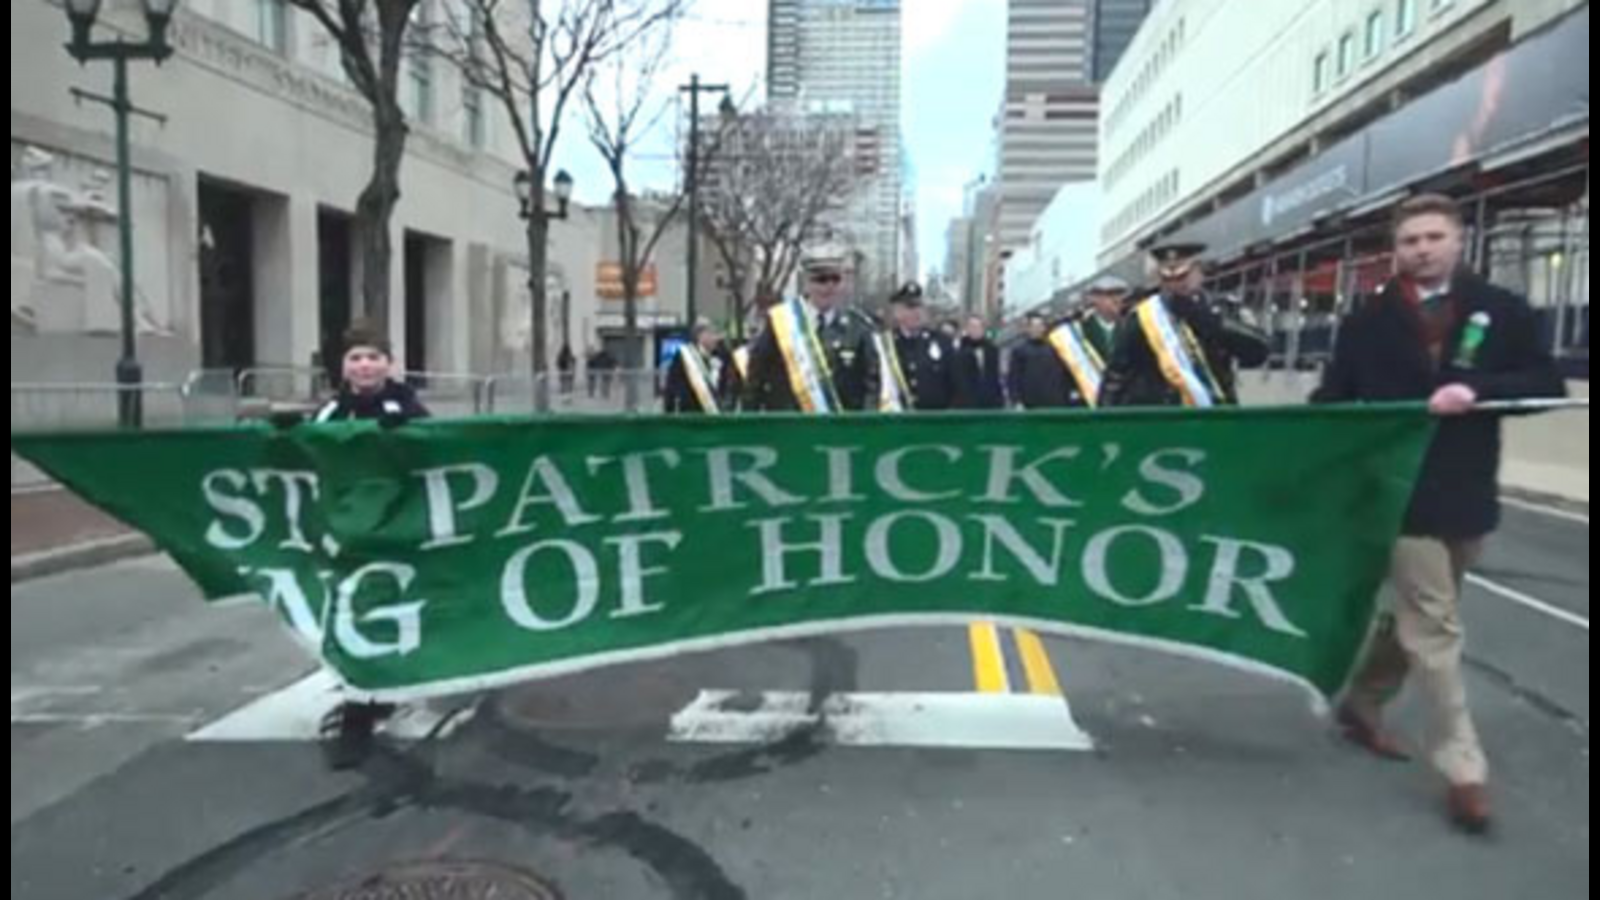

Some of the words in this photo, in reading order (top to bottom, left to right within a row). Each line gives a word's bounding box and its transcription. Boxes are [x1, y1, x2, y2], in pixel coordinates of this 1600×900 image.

[411, 443, 1207, 552] PATRICK'S
[500, 530, 683, 631] OF
[745, 510, 1307, 637] HONOR
